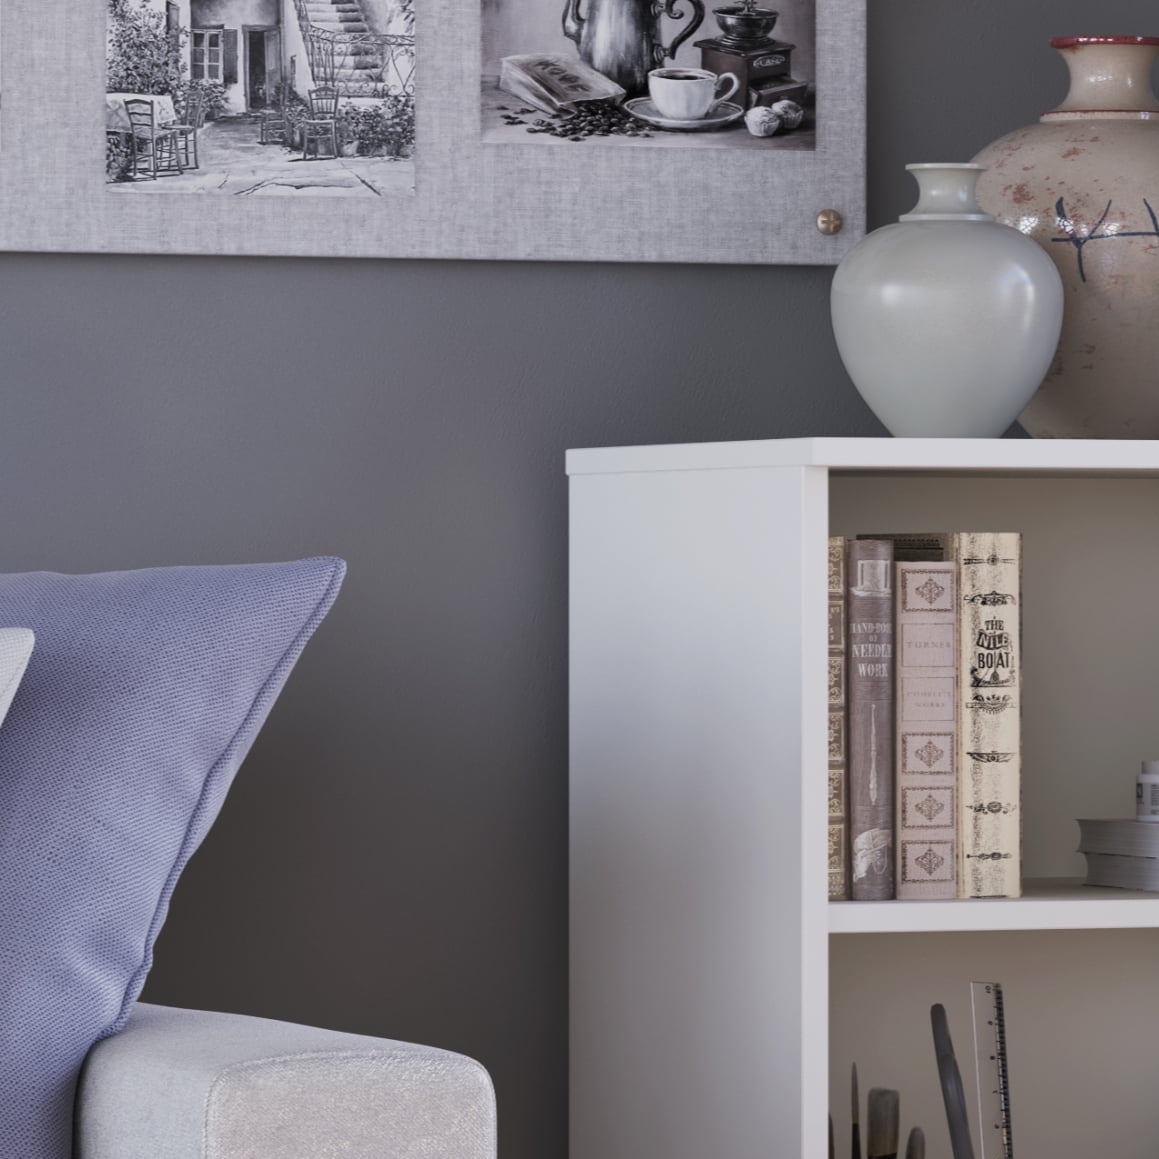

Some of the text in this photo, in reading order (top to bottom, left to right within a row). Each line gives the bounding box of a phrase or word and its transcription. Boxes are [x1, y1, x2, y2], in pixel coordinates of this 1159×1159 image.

[984, 619, 1005, 631] THE
[978, 633, 1010, 649] NILE
[977, 652, 1011, 669] BOAT
[857, 663, 889, 678] WORK
